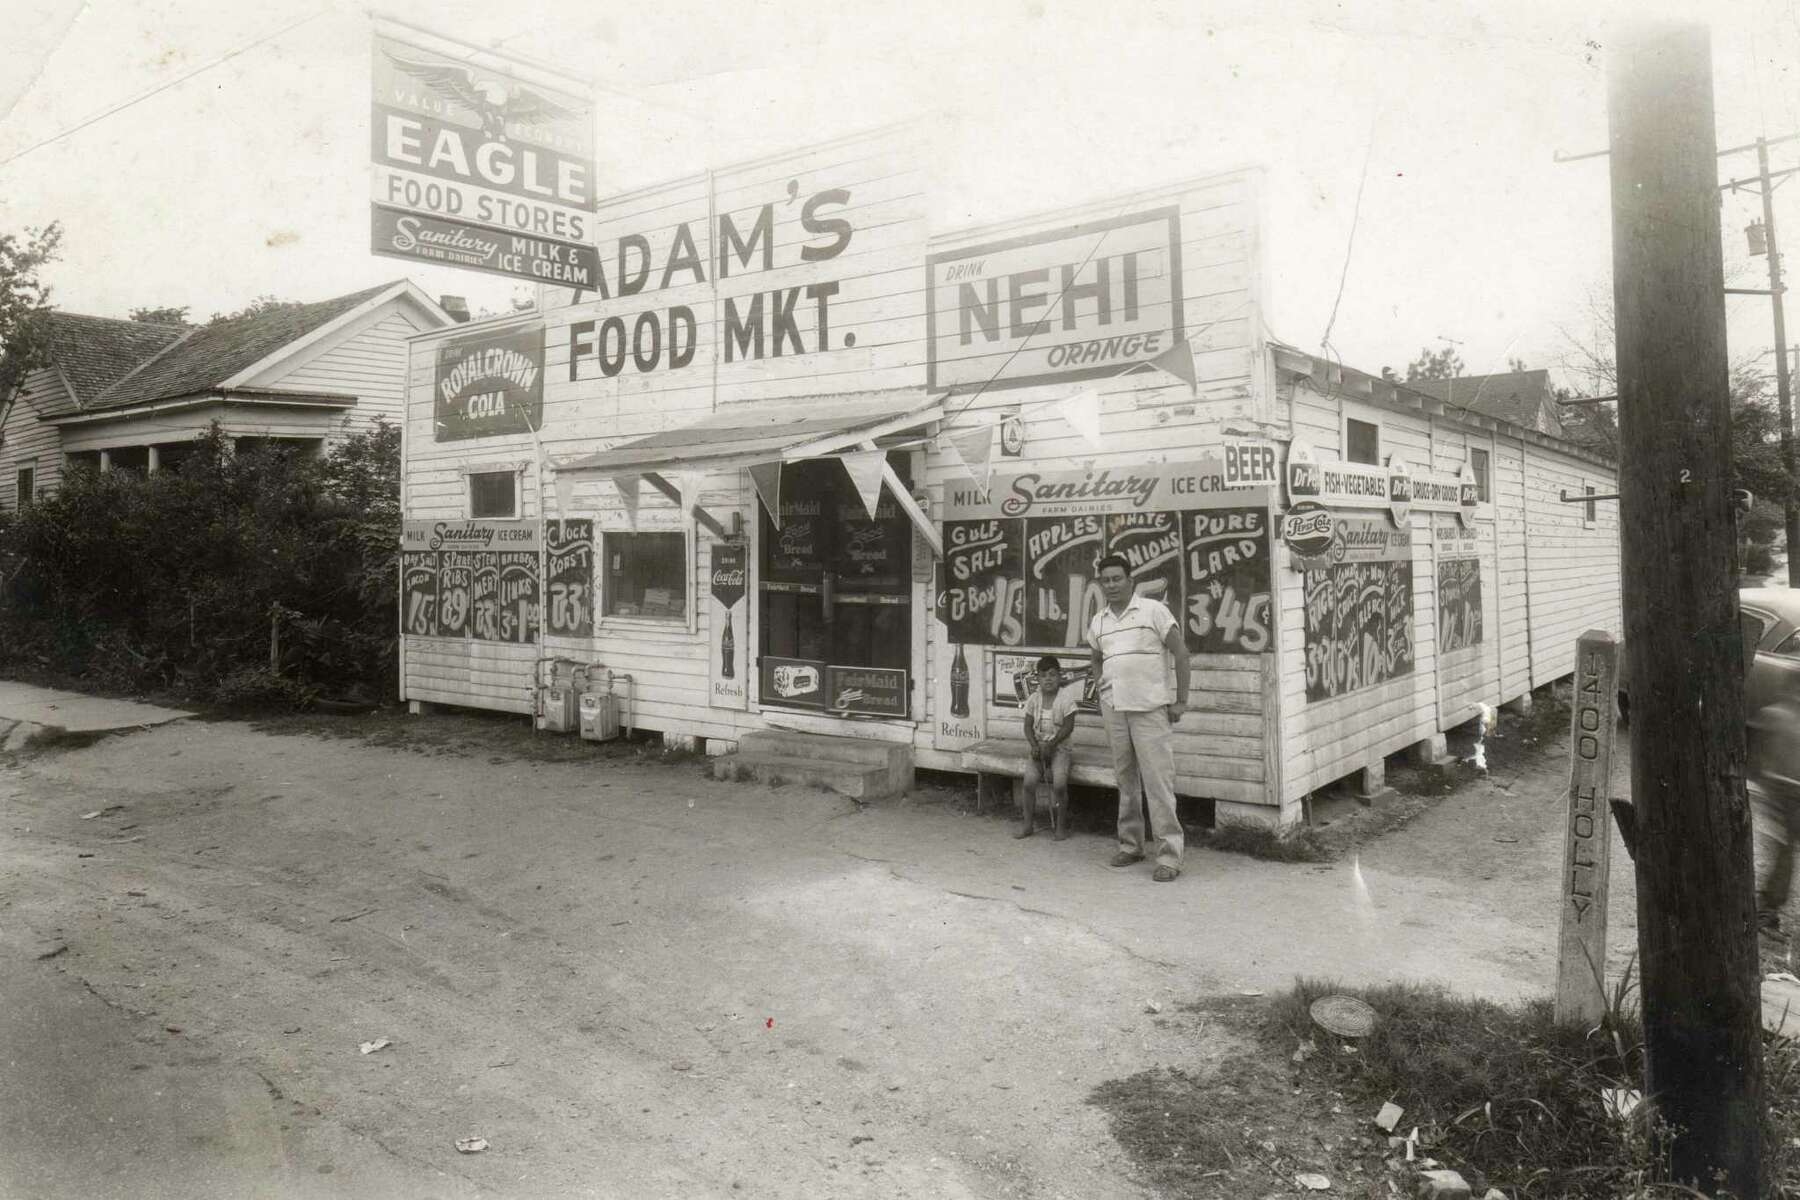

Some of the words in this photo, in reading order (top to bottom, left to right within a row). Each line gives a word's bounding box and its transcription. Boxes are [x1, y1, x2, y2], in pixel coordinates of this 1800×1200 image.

[386, 115, 586, 204] EAGLE
[388, 174, 463, 215] FOOD
[477, 195, 585, 240] STORES
[392, 216, 499, 260] Sanitary
[511, 237, 561, 262] MILK
[569, 249, 580, 266] &
[499, 253, 522, 273] ICE
[533, 259, 589, 285] CREAM
[945, 260, 986, 281] DRINK
[958, 253, 1139, 346] NEHI
[569, 305, 697, 382] FOOD
[724, 281, 856, 363] MKT.
[1048, 331, 1166, 367] ORANGE
[468, 391, 505, 419] COLA
[1224, 445, 1277, 482] BEER
[1680, 468, 1692, 483] 2
[1001, 471, 1159, 516] Sanitary
[1172, 477, 1196, 495] ICE
[407, 529, 425, 543] MILK
[430, 522, 494, 549] Sanitary
[1029, 516, 1099, 560] APPLES
[1194, 513, 1259, 536] PURE
[1334, 520, 1388, 560] Sanitary
[953, 543, 1008, 580] SALT
[1190, 540, 1257, 580] LARD
[443, 570, 468, 588] RIBS
[502, 575, 532, 606] LINKS
[715, 682, 743, 697] Refresh
[1579, 652, 1602, 761] 1400
[941, 722, 981, 739] Refresh
[1571, 785, 1596, 924] HOLLY
